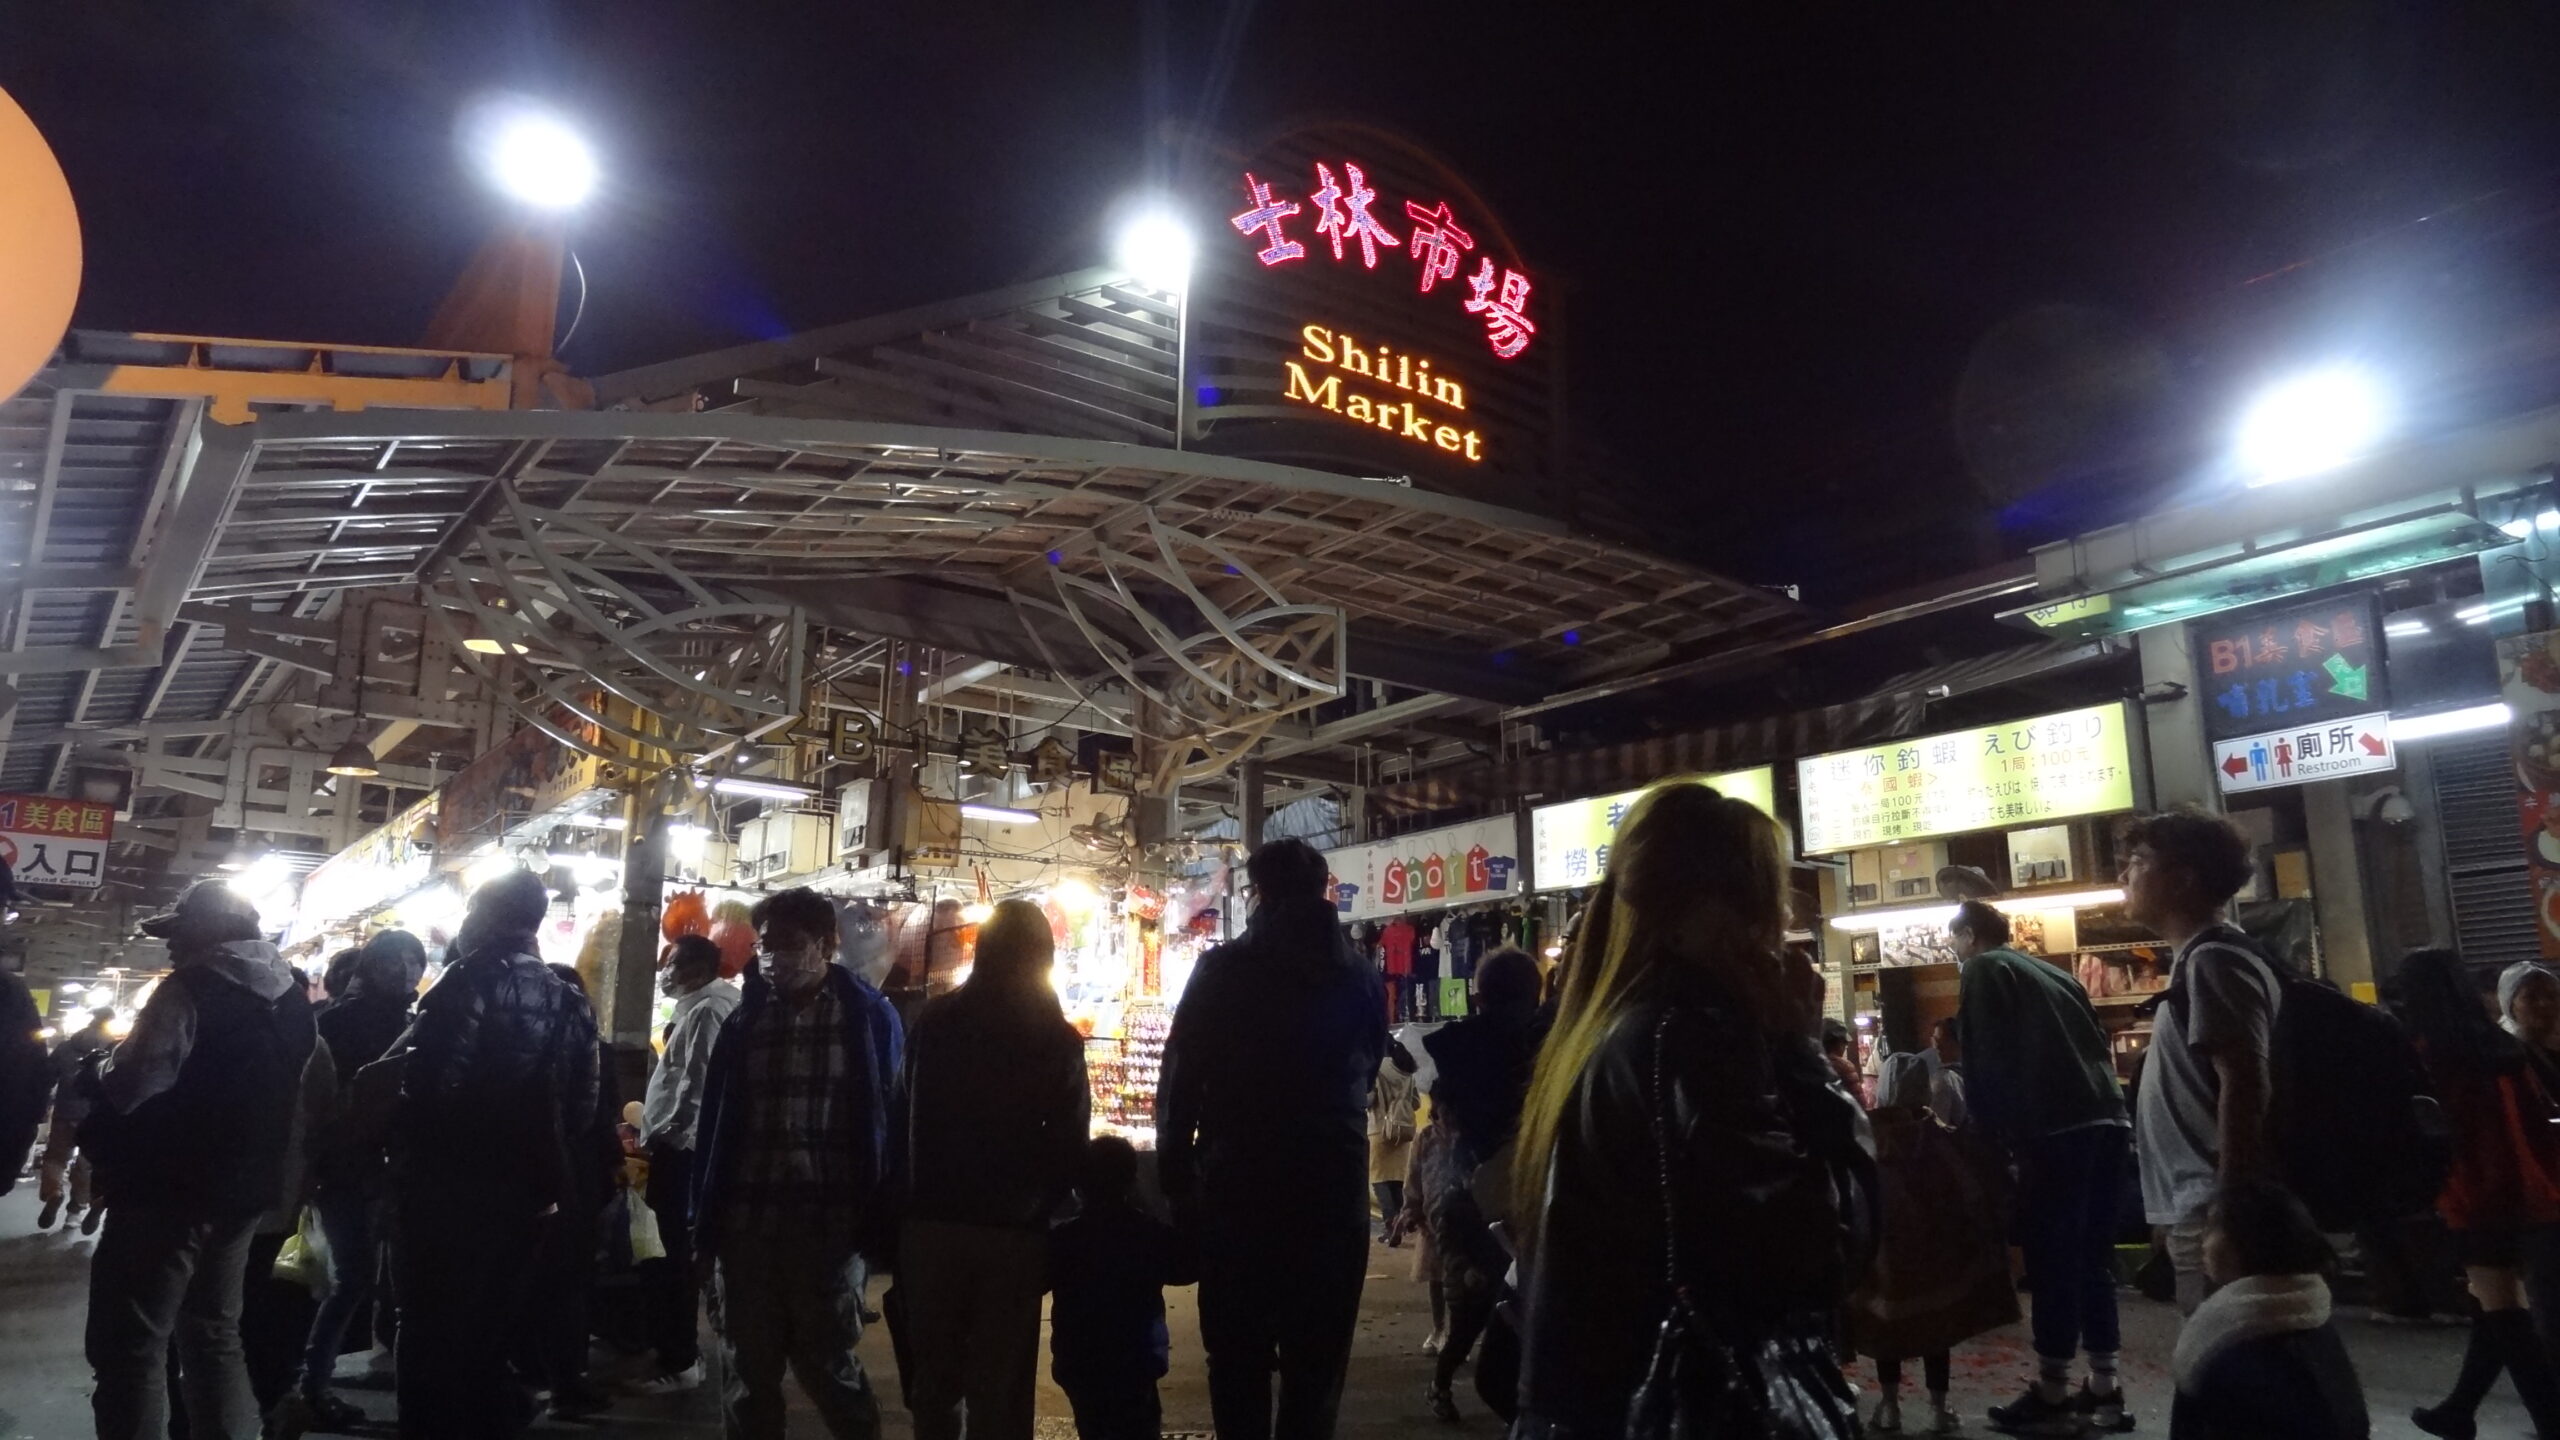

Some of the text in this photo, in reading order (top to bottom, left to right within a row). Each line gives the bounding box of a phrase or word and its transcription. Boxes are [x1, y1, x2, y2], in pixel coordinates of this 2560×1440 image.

[1231, 162, 1535, 358] 士林市場
[1302, 324, 1466, 410] Shilin
[1284, 361, 1481, 461] Market
[2296, 725, 2354, 761] 廁所
[2297, 756, 2361, 776] Restroom
[21, 843, 100, 877] 入口
[1386, 855, 1483, 901] Sport
